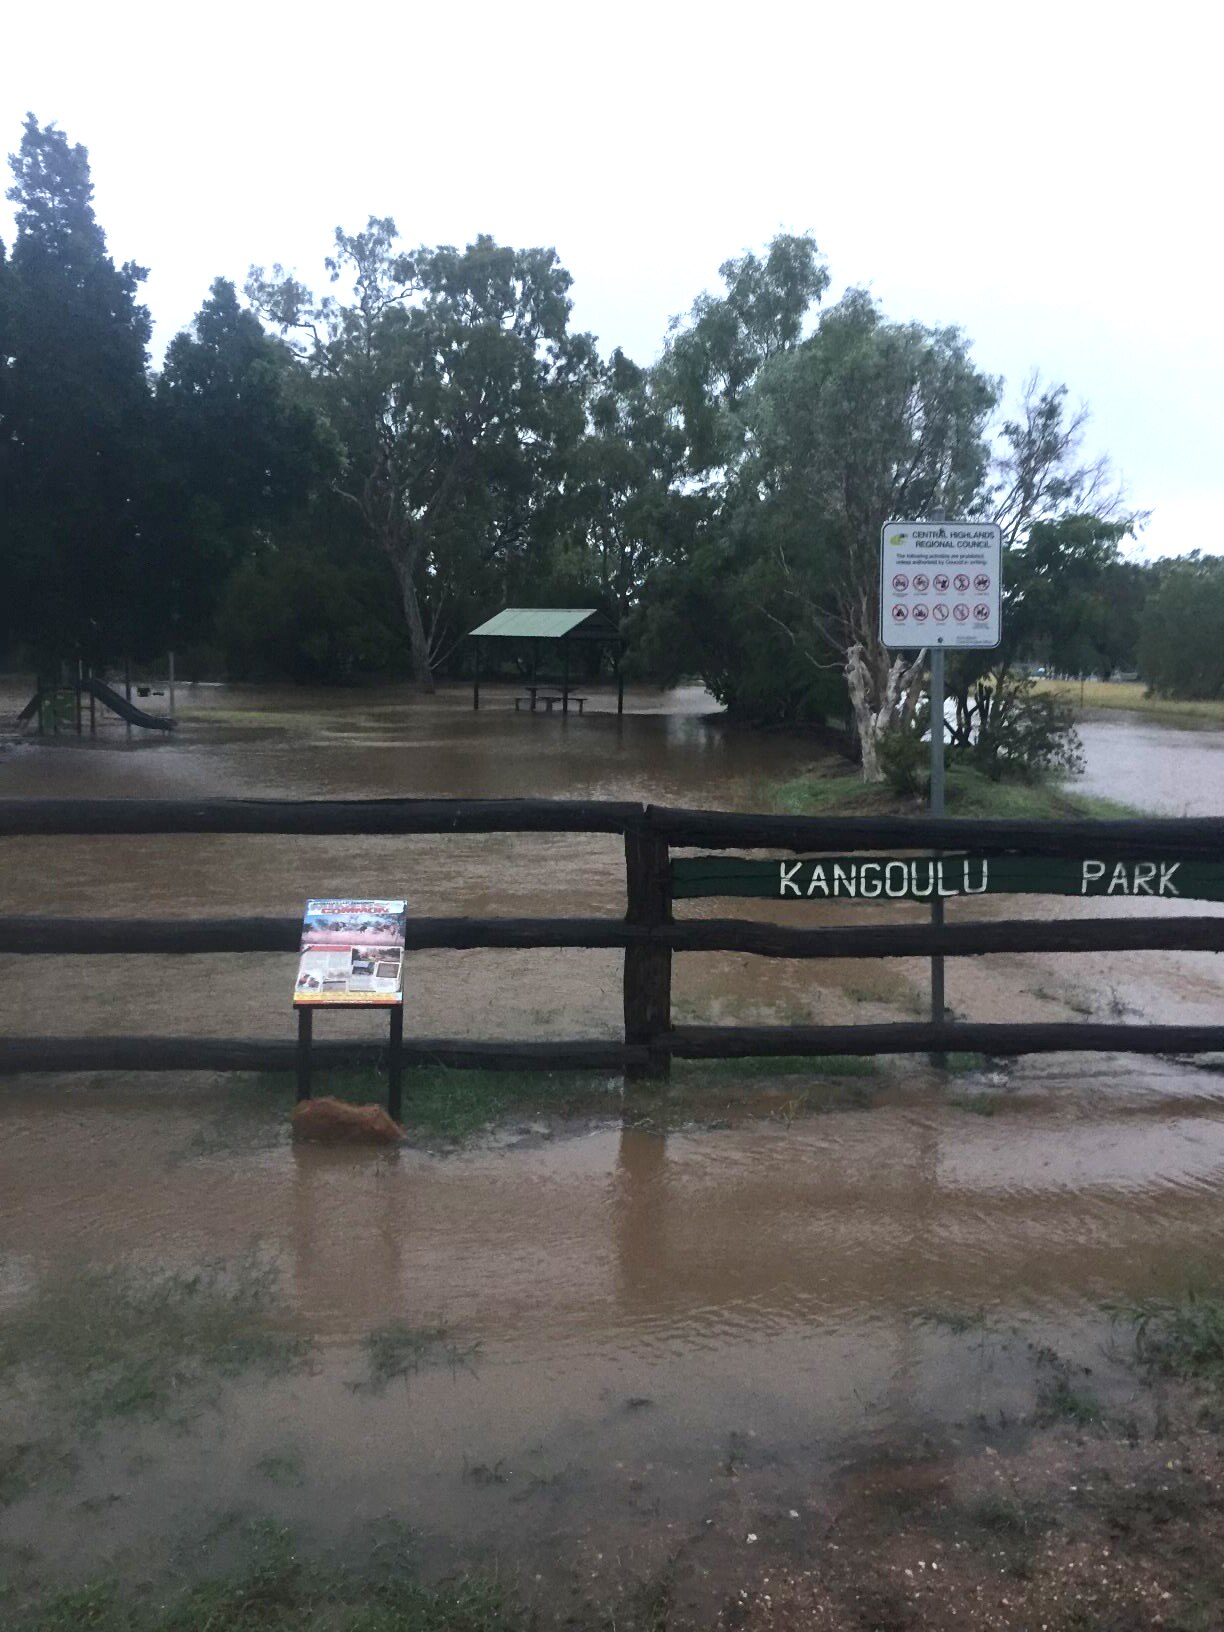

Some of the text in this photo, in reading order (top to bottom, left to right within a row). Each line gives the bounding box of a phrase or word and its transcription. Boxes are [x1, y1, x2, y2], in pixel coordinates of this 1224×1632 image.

[912, 531, 995, 539] CENTRAL HIGHLANDS
[915, 540, 991, 549] REGIONAL COUNCIL
[779, 859, 1182, 897] KANGOULU PARK
